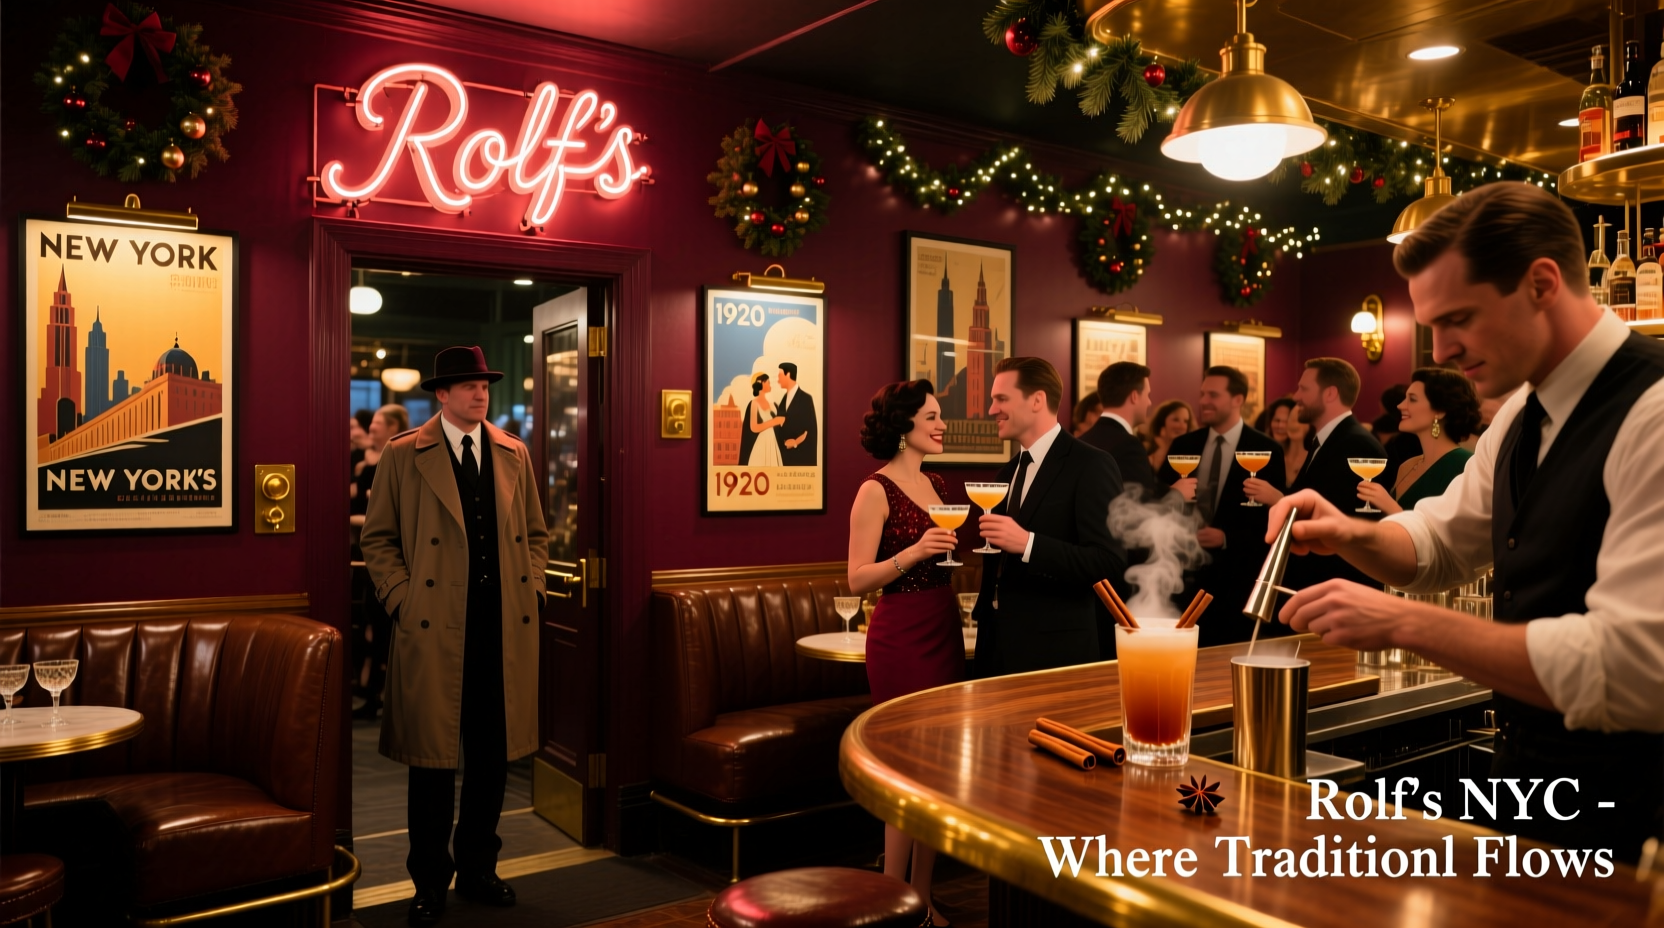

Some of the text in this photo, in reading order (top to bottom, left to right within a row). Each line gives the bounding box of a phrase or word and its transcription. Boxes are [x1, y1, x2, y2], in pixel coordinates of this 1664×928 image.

[320, 62, 650, 226] Rolf's
[40, 231, 218, 271] NEW YORK
[715, 302, 766, 327] 1920
[46, 468, 217, 491] NEW YORK'S
[715, 471, 770, 497] 1920
